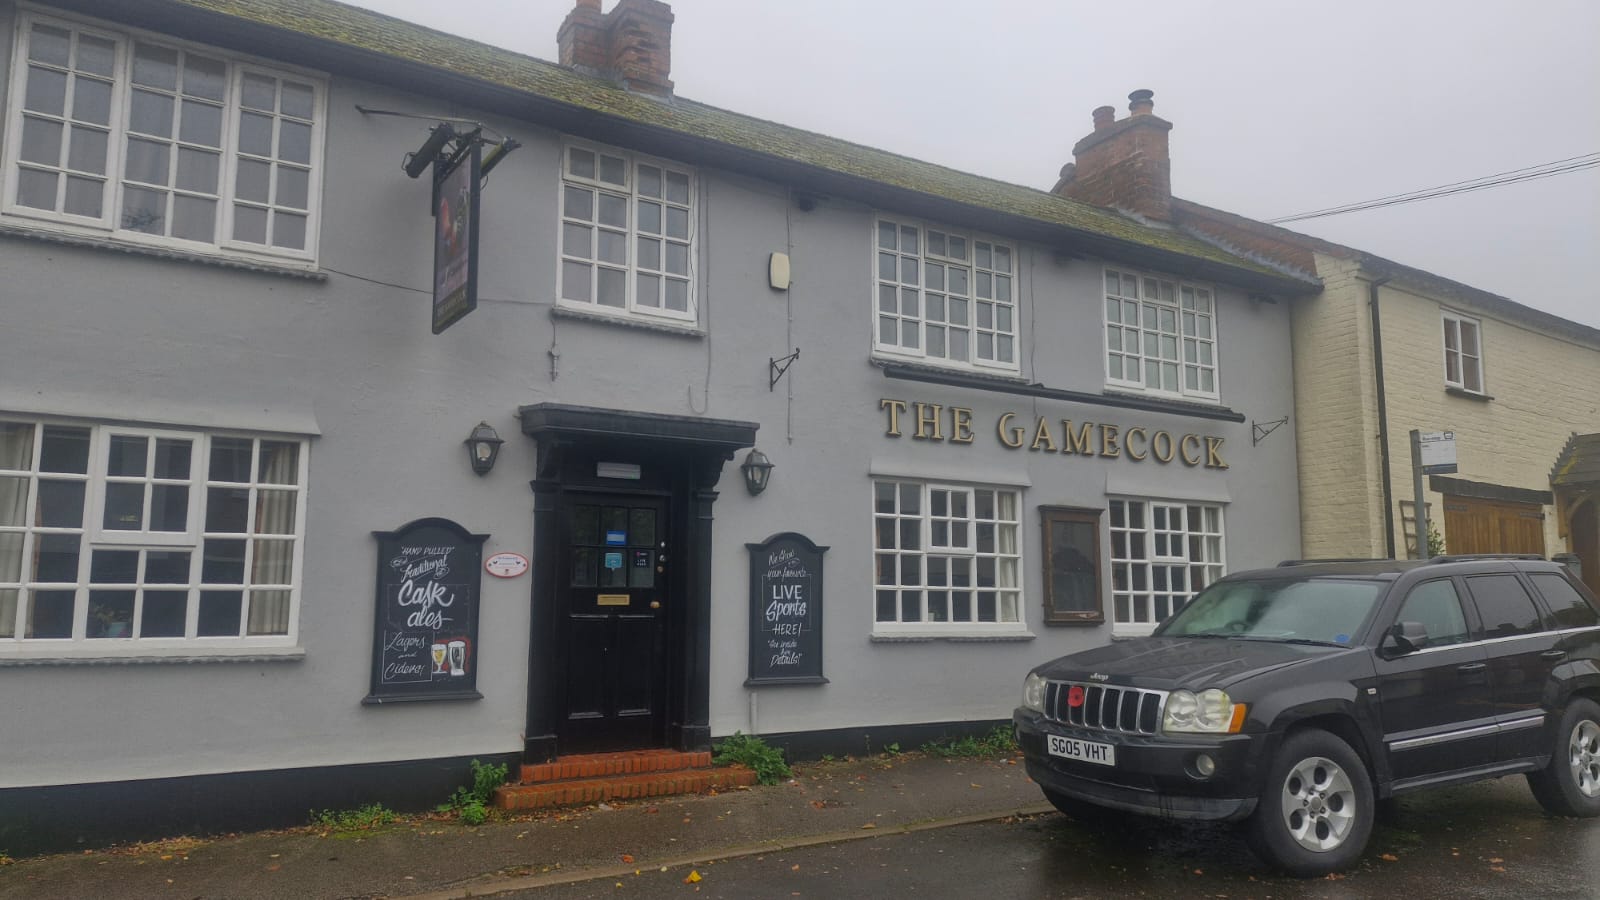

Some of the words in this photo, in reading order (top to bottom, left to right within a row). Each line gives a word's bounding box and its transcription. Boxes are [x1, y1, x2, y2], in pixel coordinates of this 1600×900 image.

[880, 398, 974, 444] THE
[997, 411, 1230, 470] GAMECOCK
[398, 579, 455, 607] Cask
[772, 584, 802, 600] LIVE
[766, 600, 807, 622] Sports
[1052, 737, 1081, 756] SG05
[1084, 742, 1109, 761] VHT
